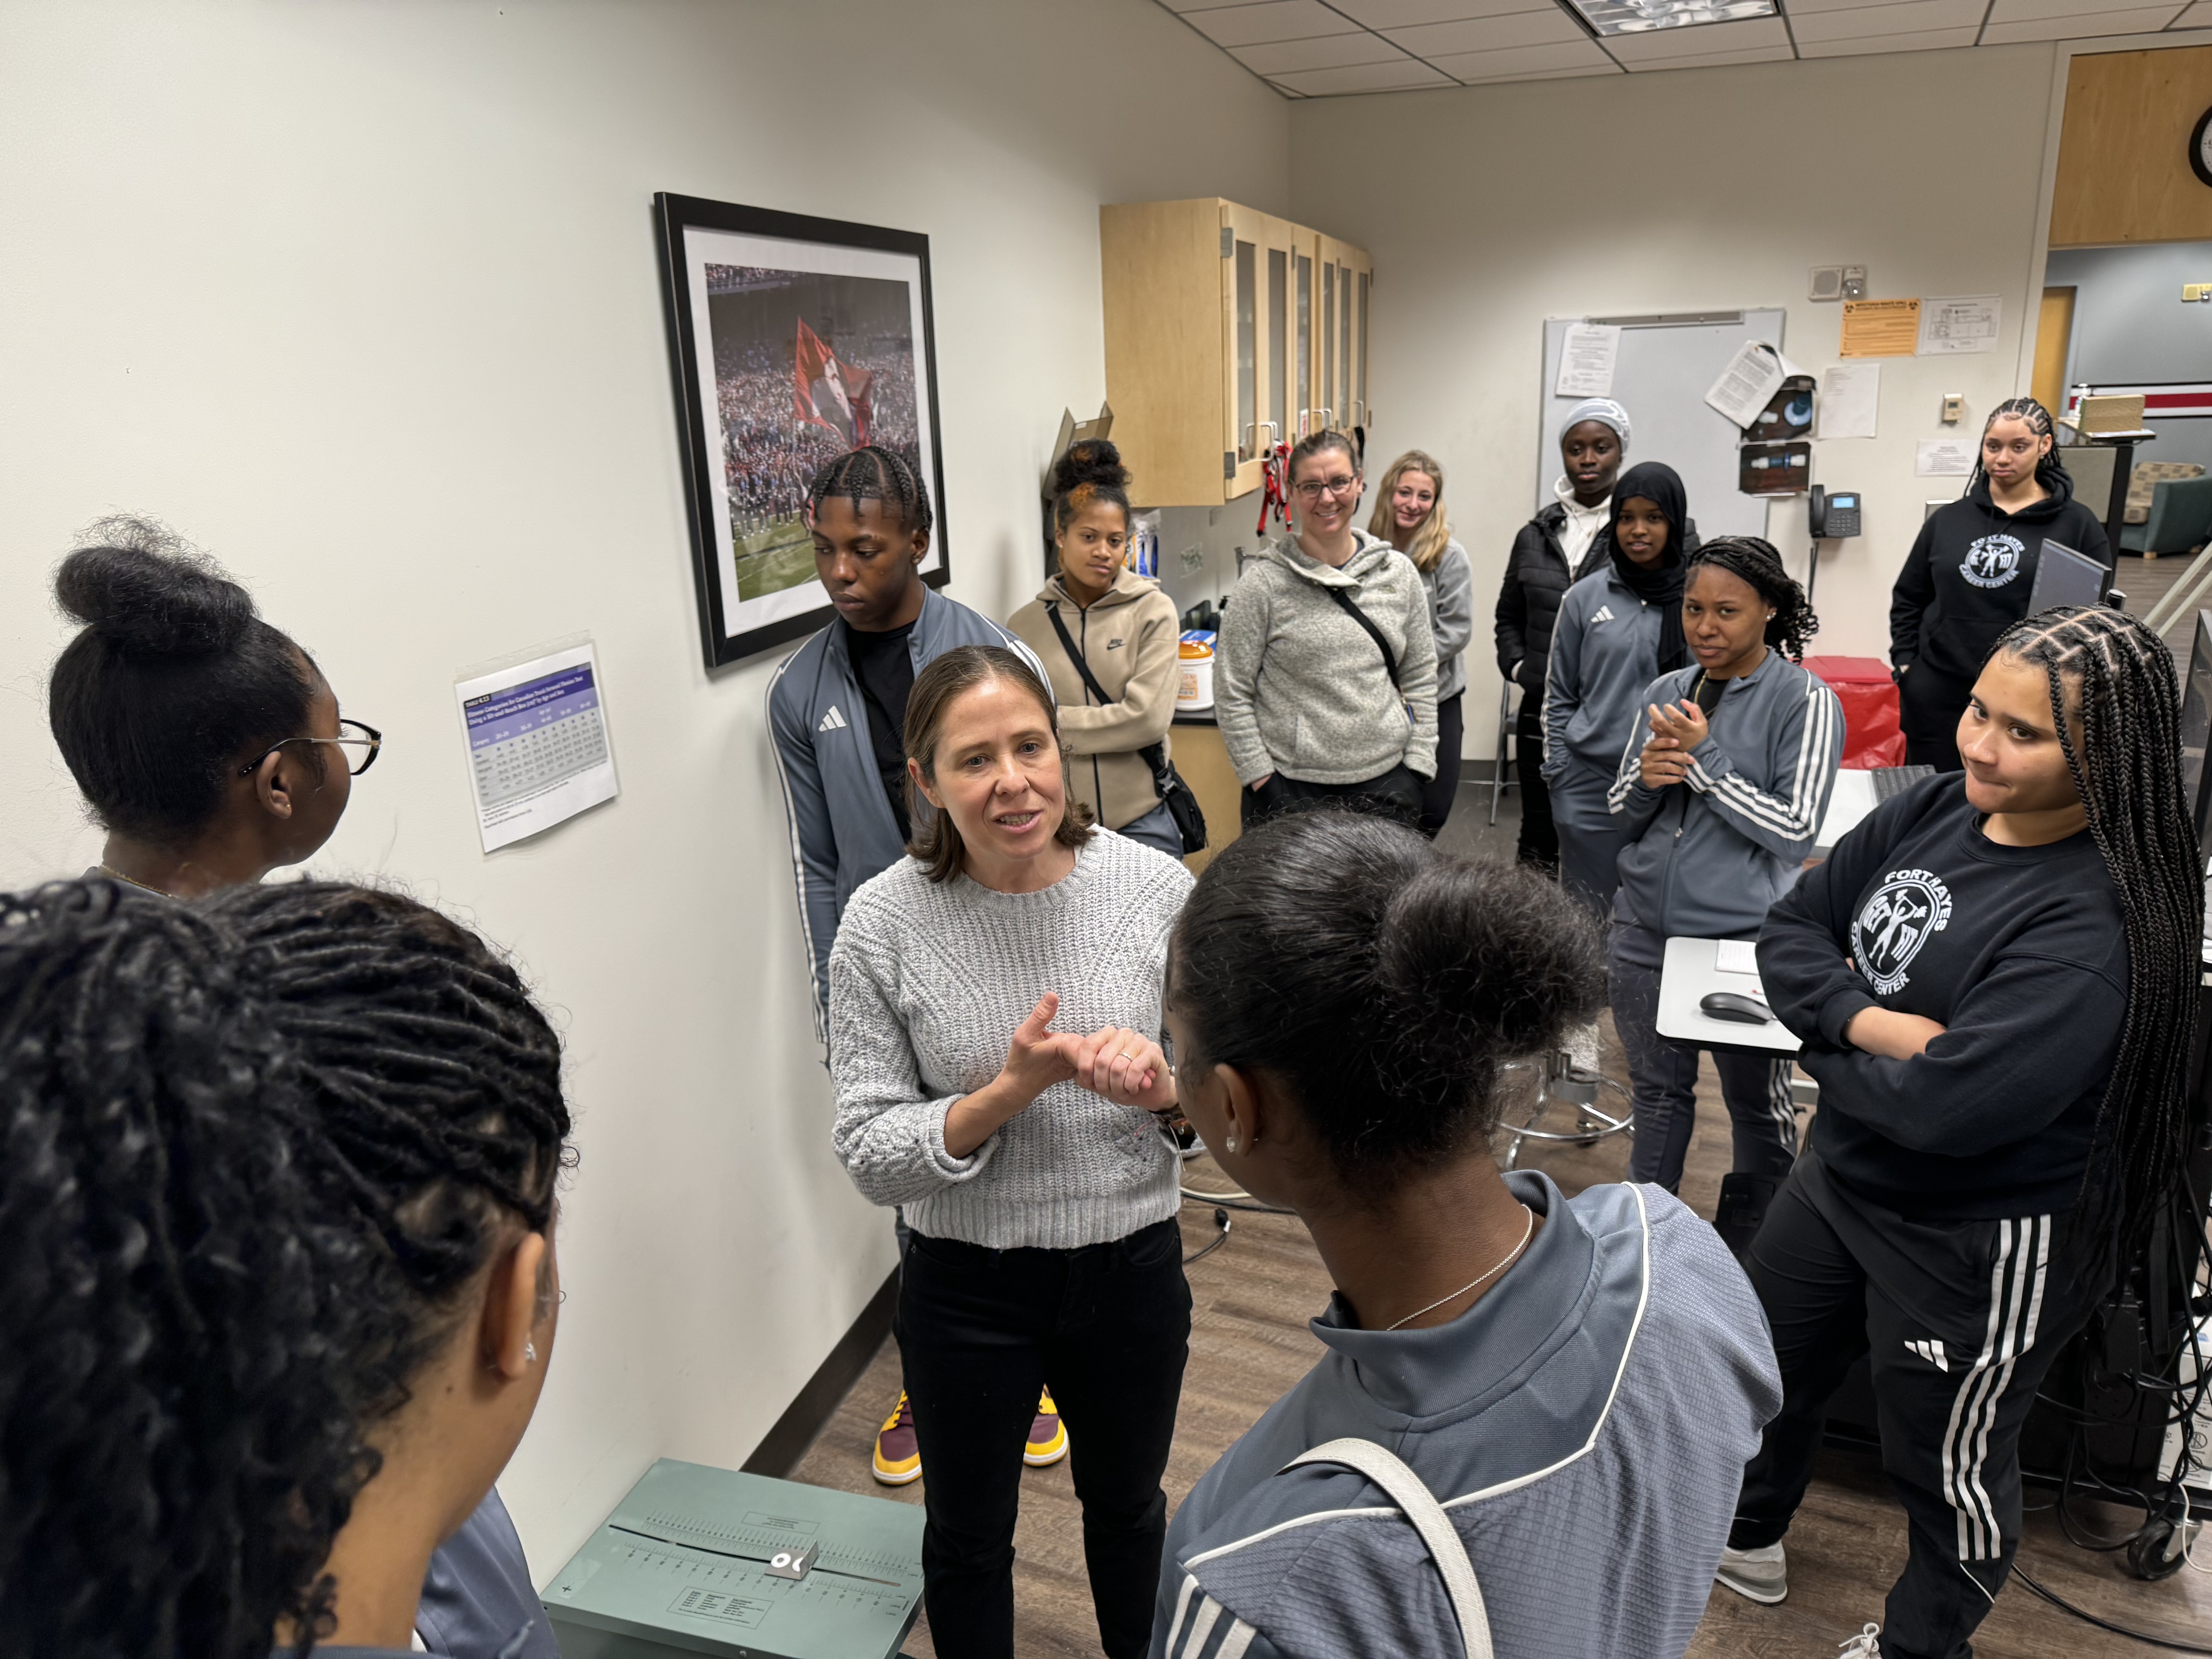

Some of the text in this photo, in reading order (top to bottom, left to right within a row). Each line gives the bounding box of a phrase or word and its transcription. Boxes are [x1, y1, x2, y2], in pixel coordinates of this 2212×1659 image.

[1885, 869, 1952, 931] FORT HAYES
[1874, 972, 1910, 995] CENTER
